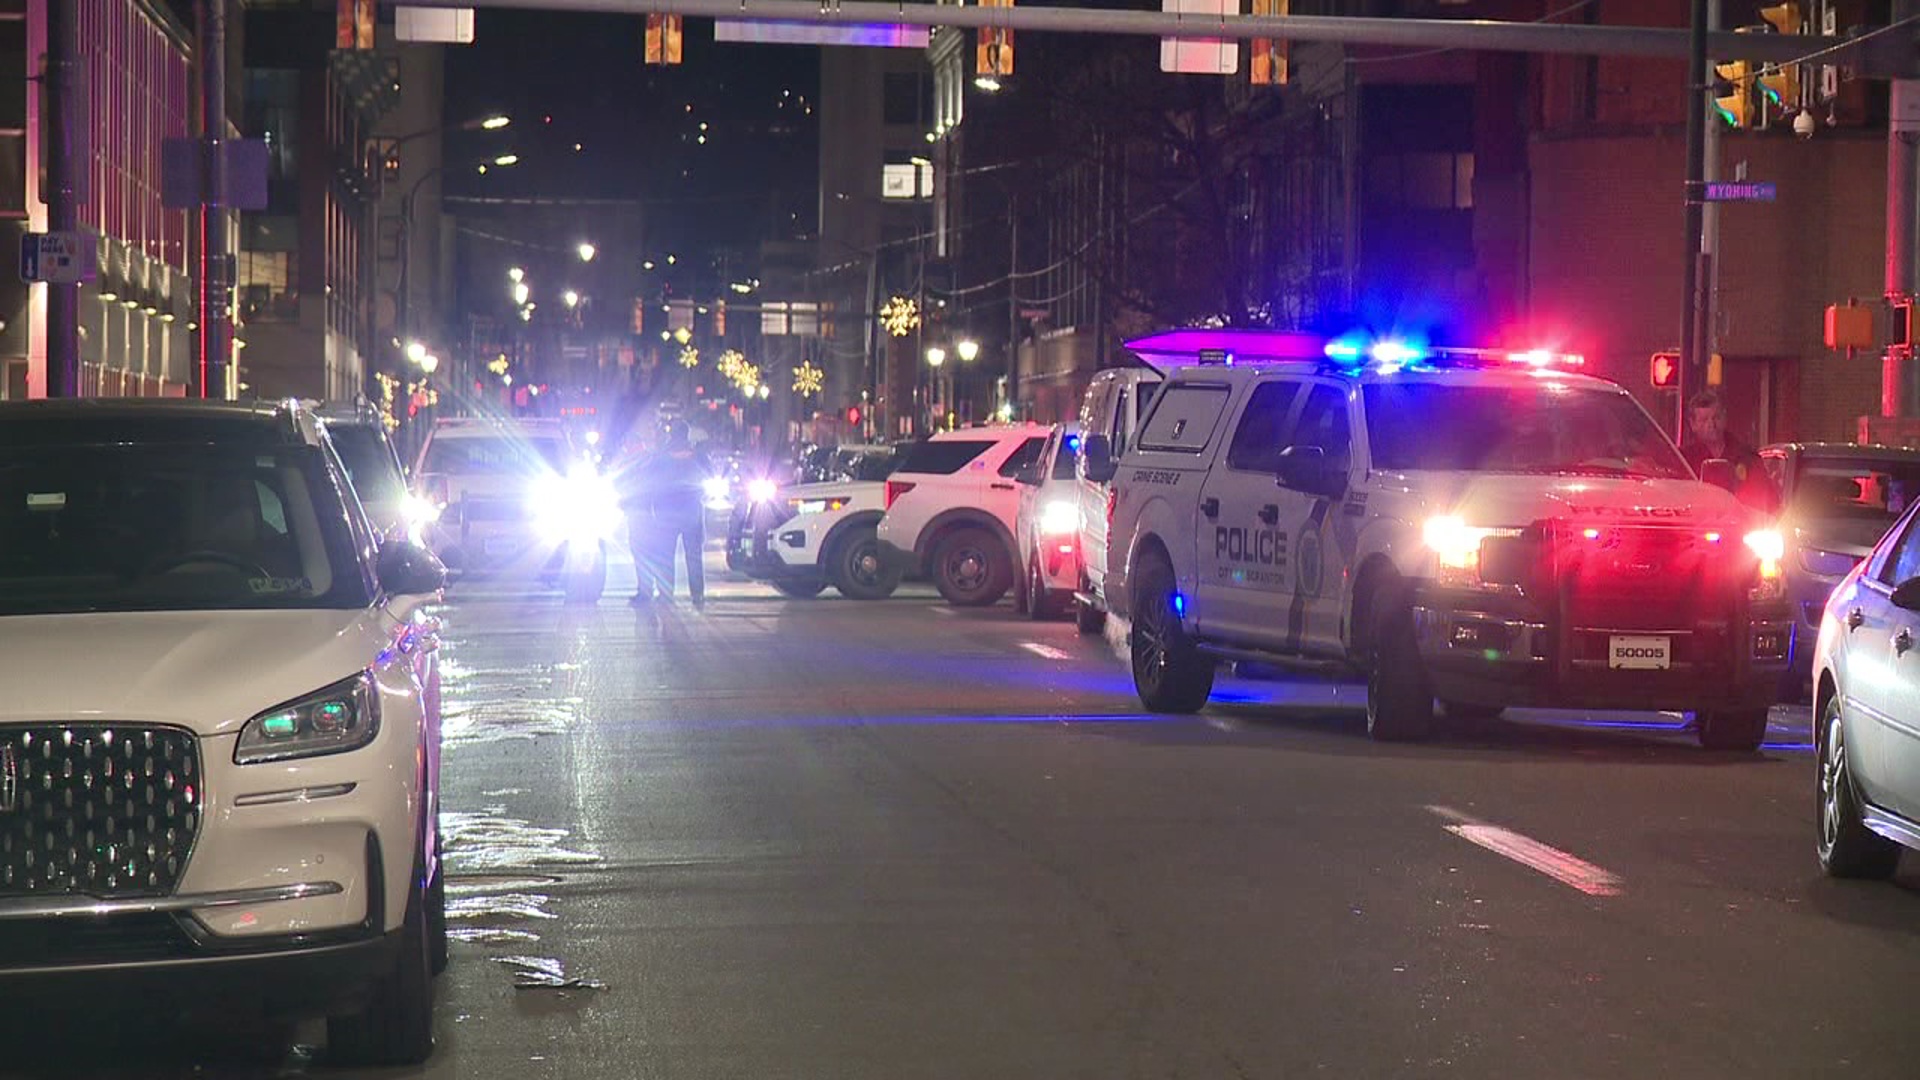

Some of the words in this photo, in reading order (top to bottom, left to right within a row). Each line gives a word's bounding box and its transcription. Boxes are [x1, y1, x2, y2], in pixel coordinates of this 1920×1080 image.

[1708, 184, 1759, 199] WYOMING
[41, 237, 59, 245] PAY
[1132, 471, 1154, 482] CRIME
[1151, 471, 1175, 484] SCENE
[1216, 526, 1287, 565] POLICE
[1616, 647, 1664, 658] 50005
